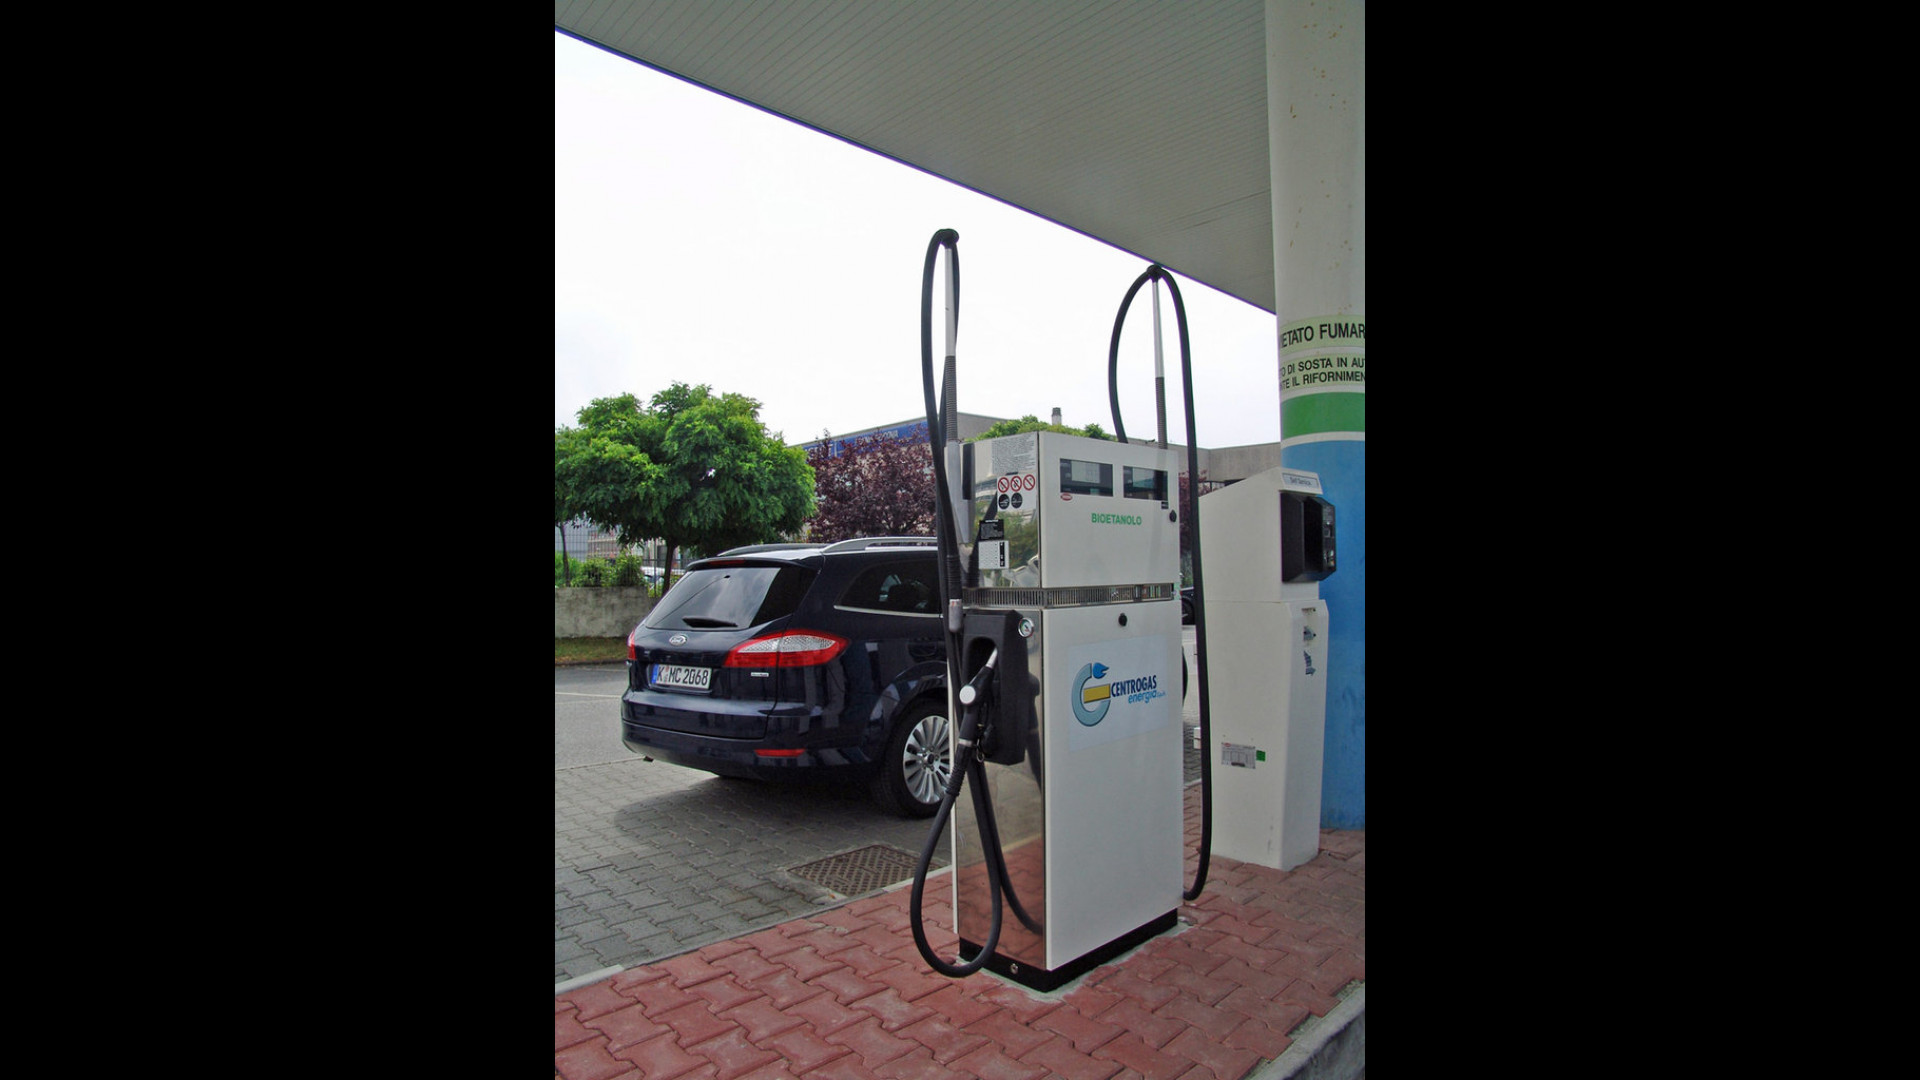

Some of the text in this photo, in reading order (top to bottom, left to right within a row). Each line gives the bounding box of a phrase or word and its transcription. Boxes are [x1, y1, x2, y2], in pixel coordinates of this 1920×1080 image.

[1287, 363, 1295, 375] DI
[1298, 358, 1333, 372] SOSTA
[1337, 357, 1347, 368] IN
[1351, 357, 1365, 368] AU
[1292, 376, 1300, 387] IL
[1091, 512, 1142, 526] BIOETANOLO
[657, 666, 709, 686] K MC 2068
[1111, 674, 1157, 697] CENTROGAS
[1128, 690, 1157, 704] energia
